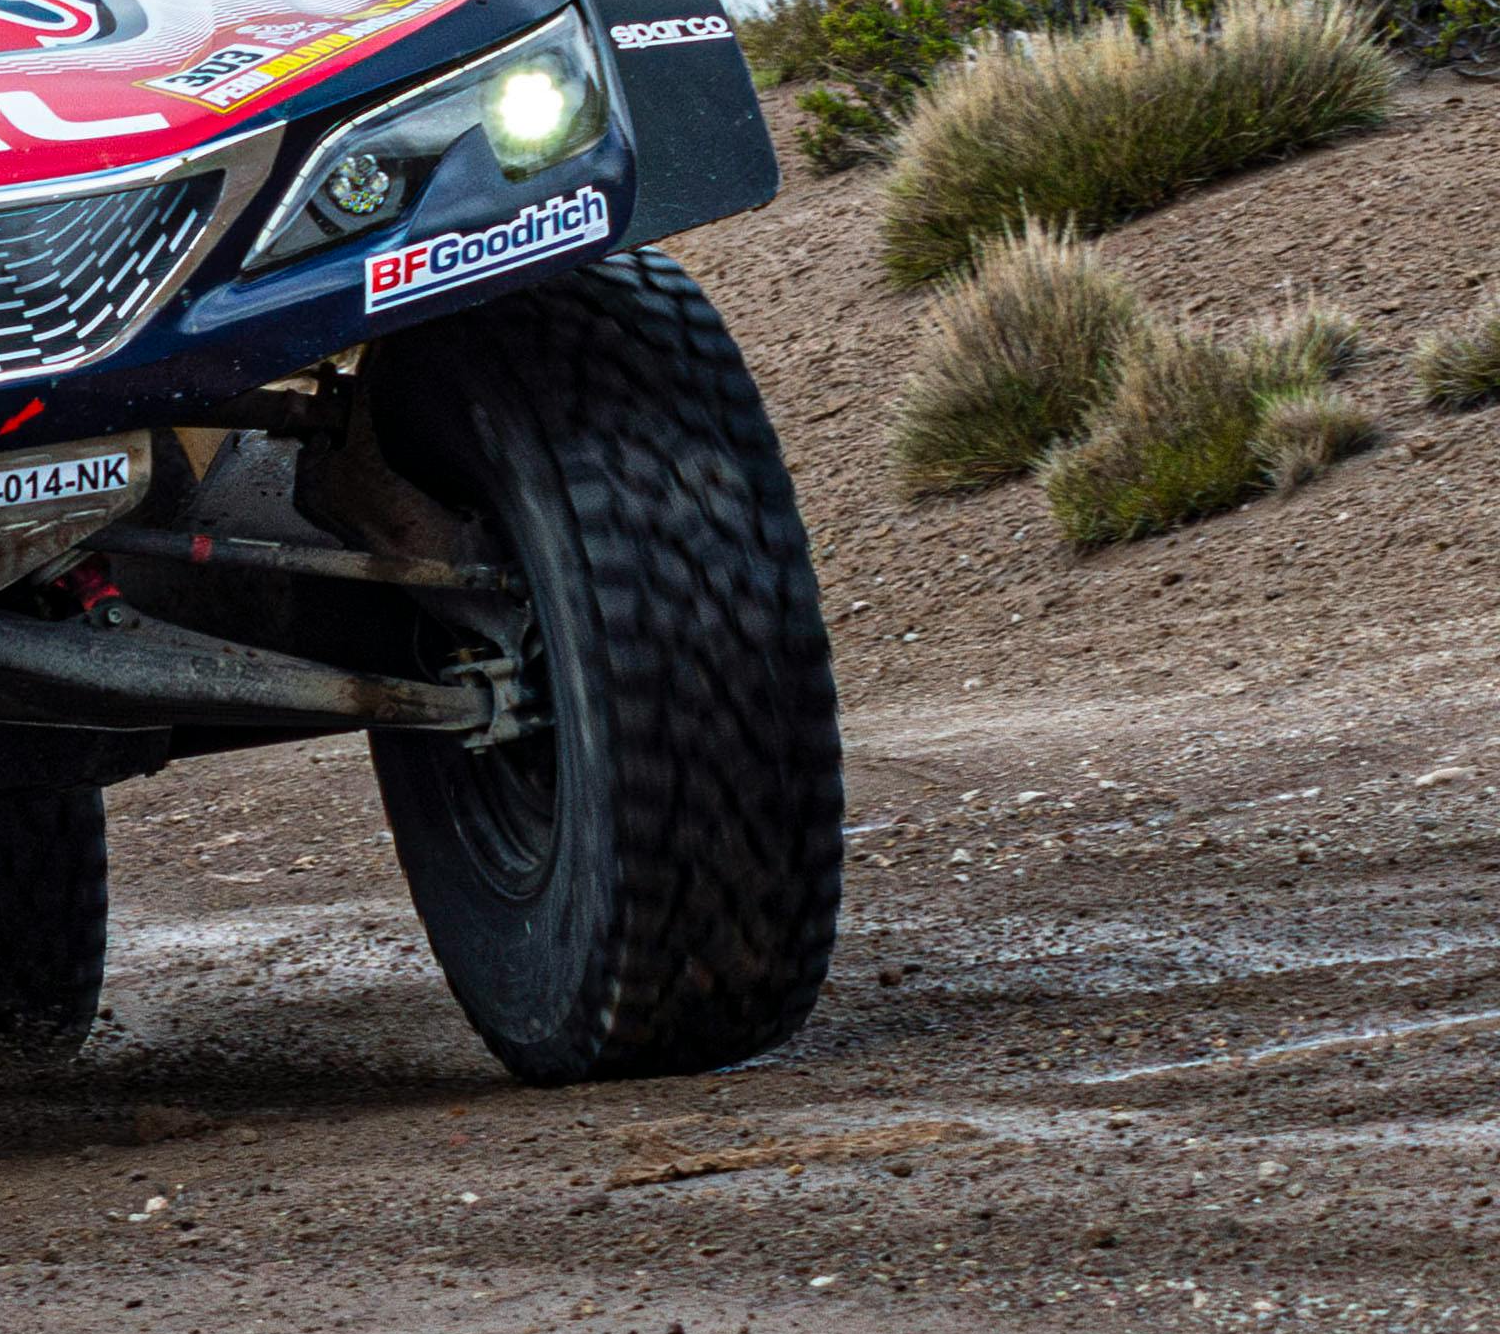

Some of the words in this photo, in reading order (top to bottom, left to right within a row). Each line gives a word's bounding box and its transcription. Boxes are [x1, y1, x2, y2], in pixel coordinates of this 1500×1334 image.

[610, 16, 729, 49] sparco
[165, 49, 264, 88] 303
[372, 193, 603, 294] BFGoodrich
